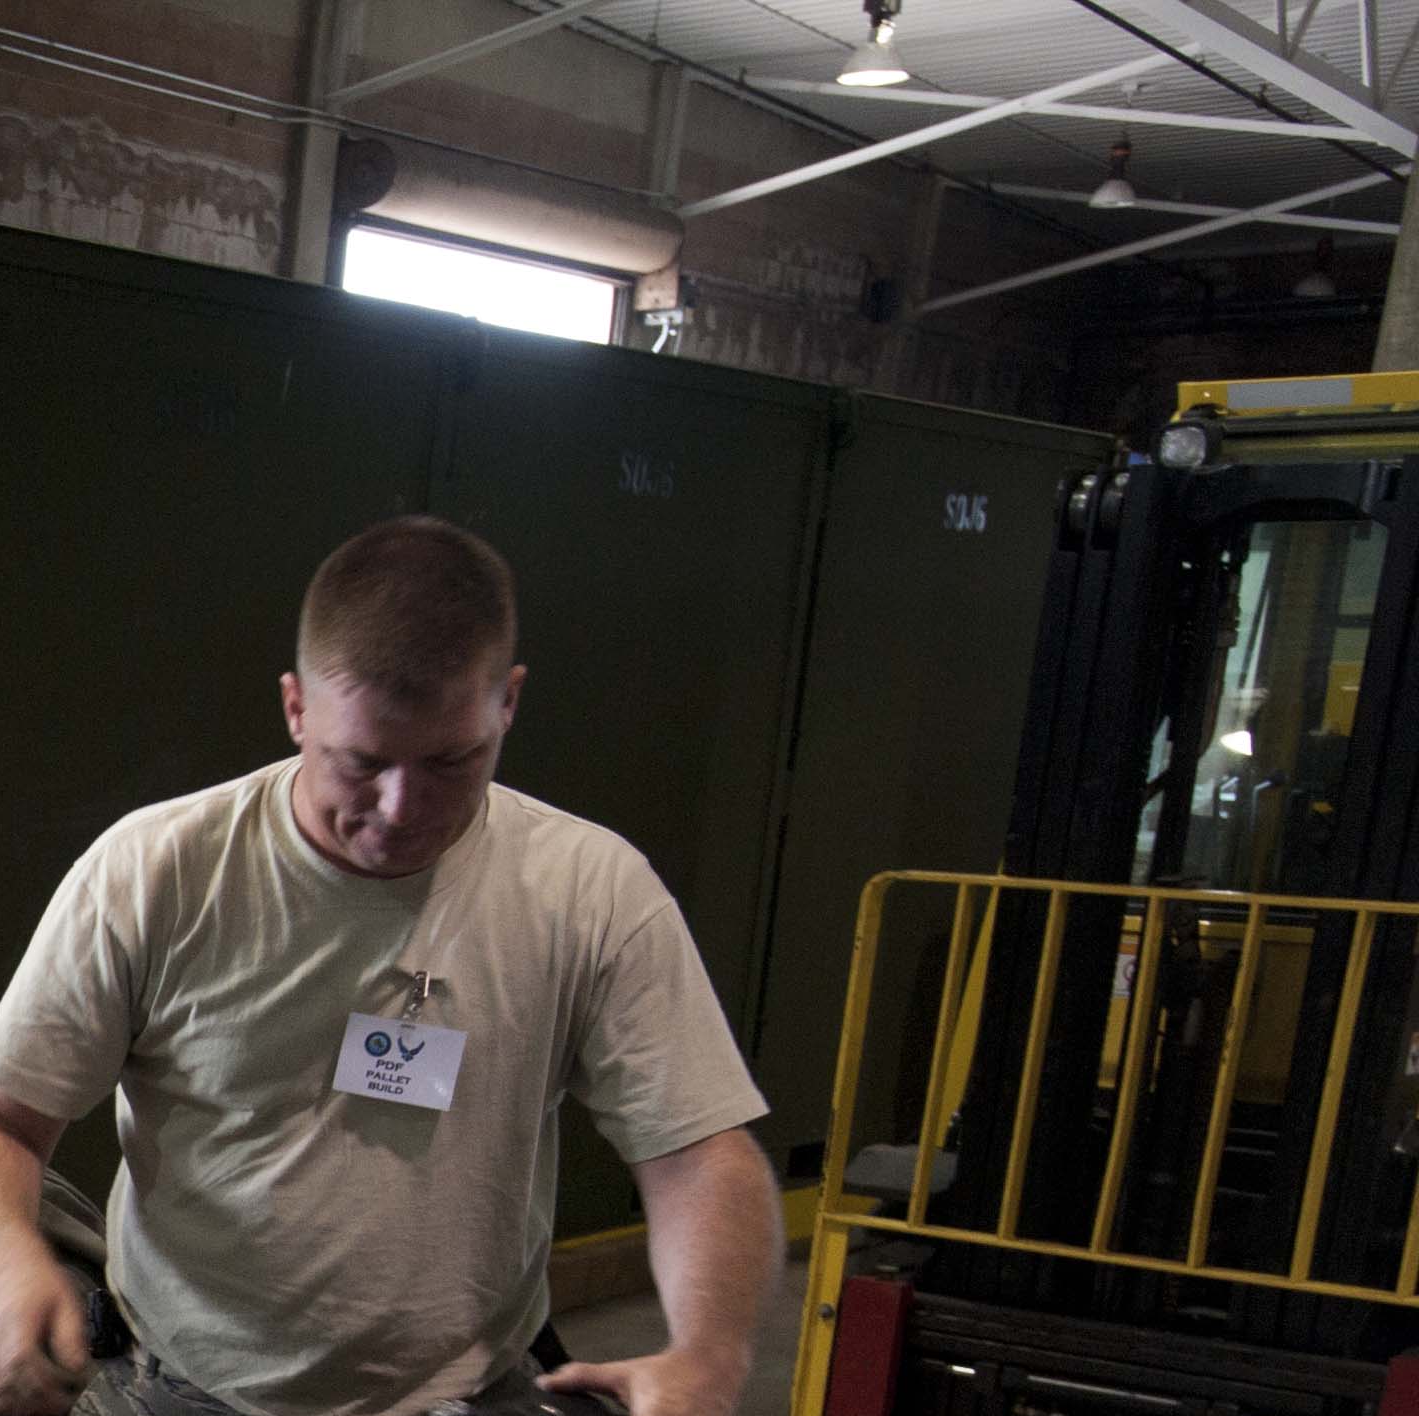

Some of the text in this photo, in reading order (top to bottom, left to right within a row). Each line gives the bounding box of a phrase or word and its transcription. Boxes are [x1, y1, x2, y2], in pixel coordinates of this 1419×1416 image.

[375, 1058, 405, 1072] PDF
[365, 1069, 412, 1085] PALLET
[367, 1081, 404, 1095] BUILD
